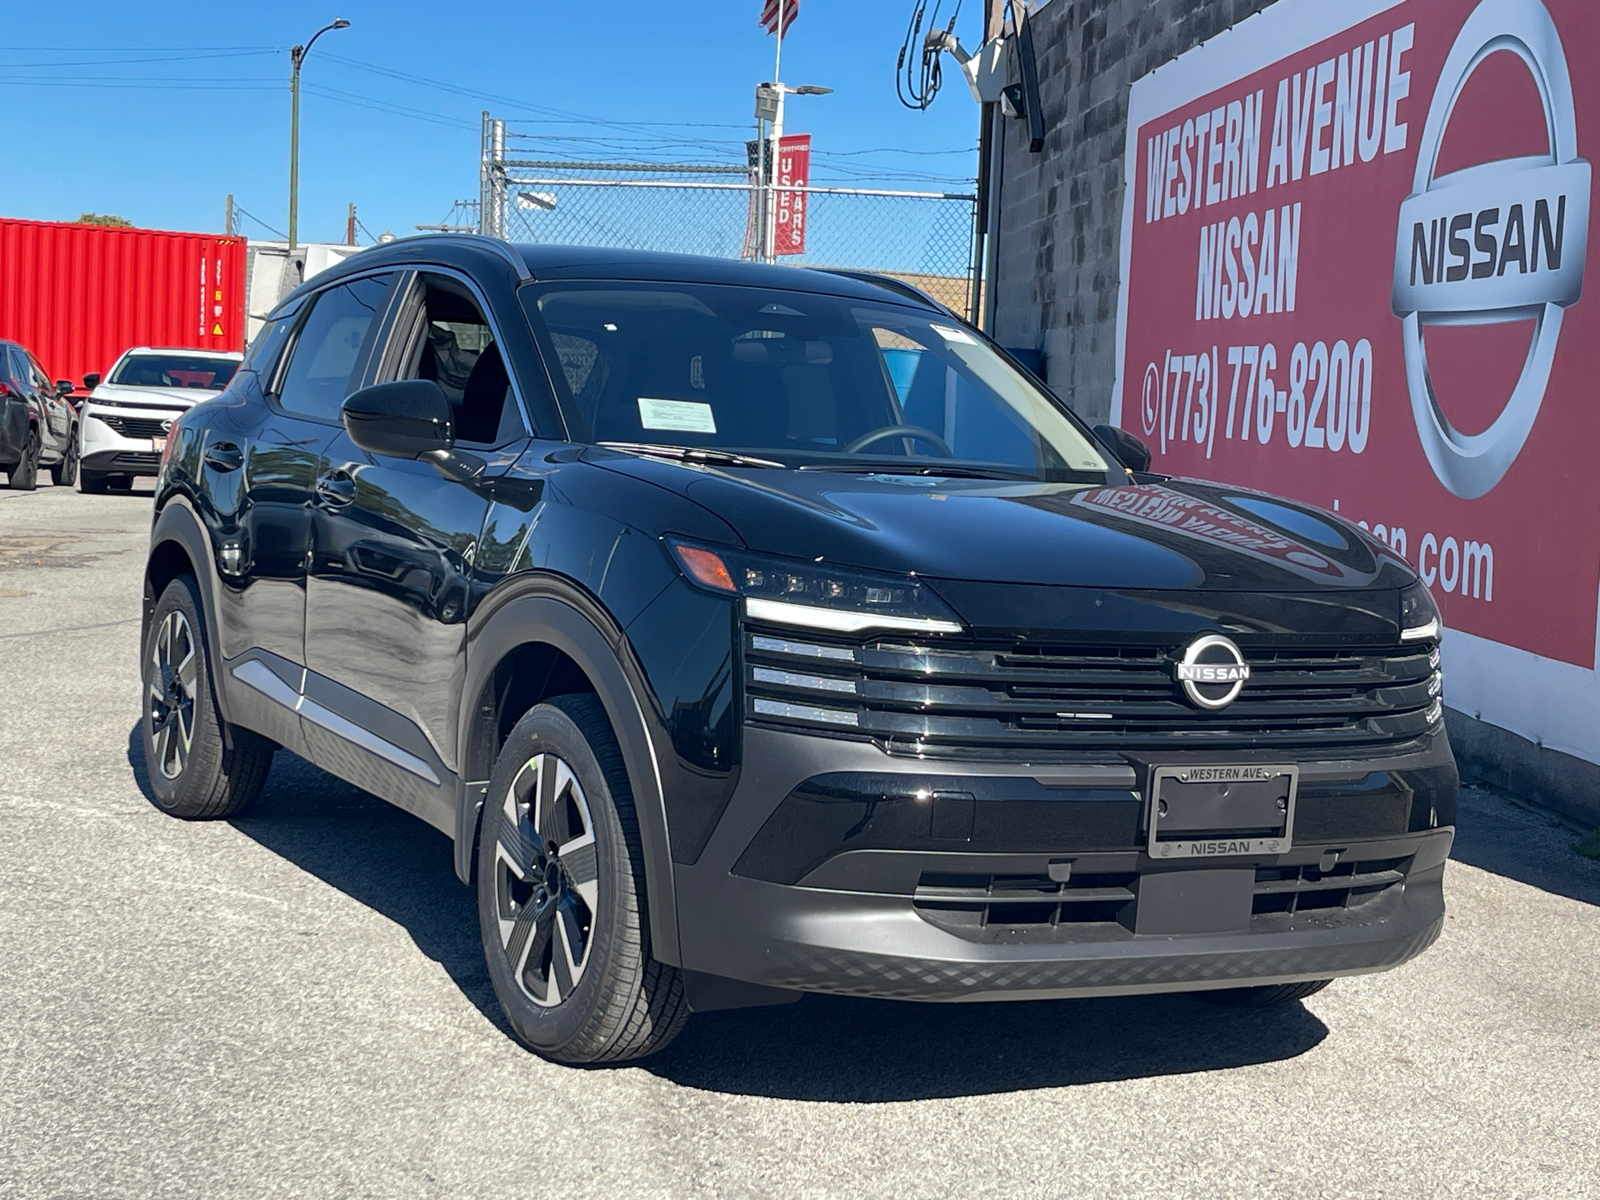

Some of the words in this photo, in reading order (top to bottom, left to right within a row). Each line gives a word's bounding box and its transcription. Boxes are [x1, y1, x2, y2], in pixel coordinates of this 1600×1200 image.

[780, 144, 809, 153] CERTIFIED
[1145, 88, 1263, 224] WESTERN
[1266, 22, 1415, 189] AVENUE
[779, 158, 791, 223] USED
[791, 180, 803, 245] CARS
[1196, 202, 1301, 321] NISSAN
[1409, 195, 1566, 287] NISSAN
[1159, 345, 1218, 459] (773)
[1226, 338, 1373, 454] 776-8200
[1179, 665, 1249, 680] NISSAN
[1189, 768, 1239, 780] WESTERN
[1191, 842, 1250, 855] NISSAN
